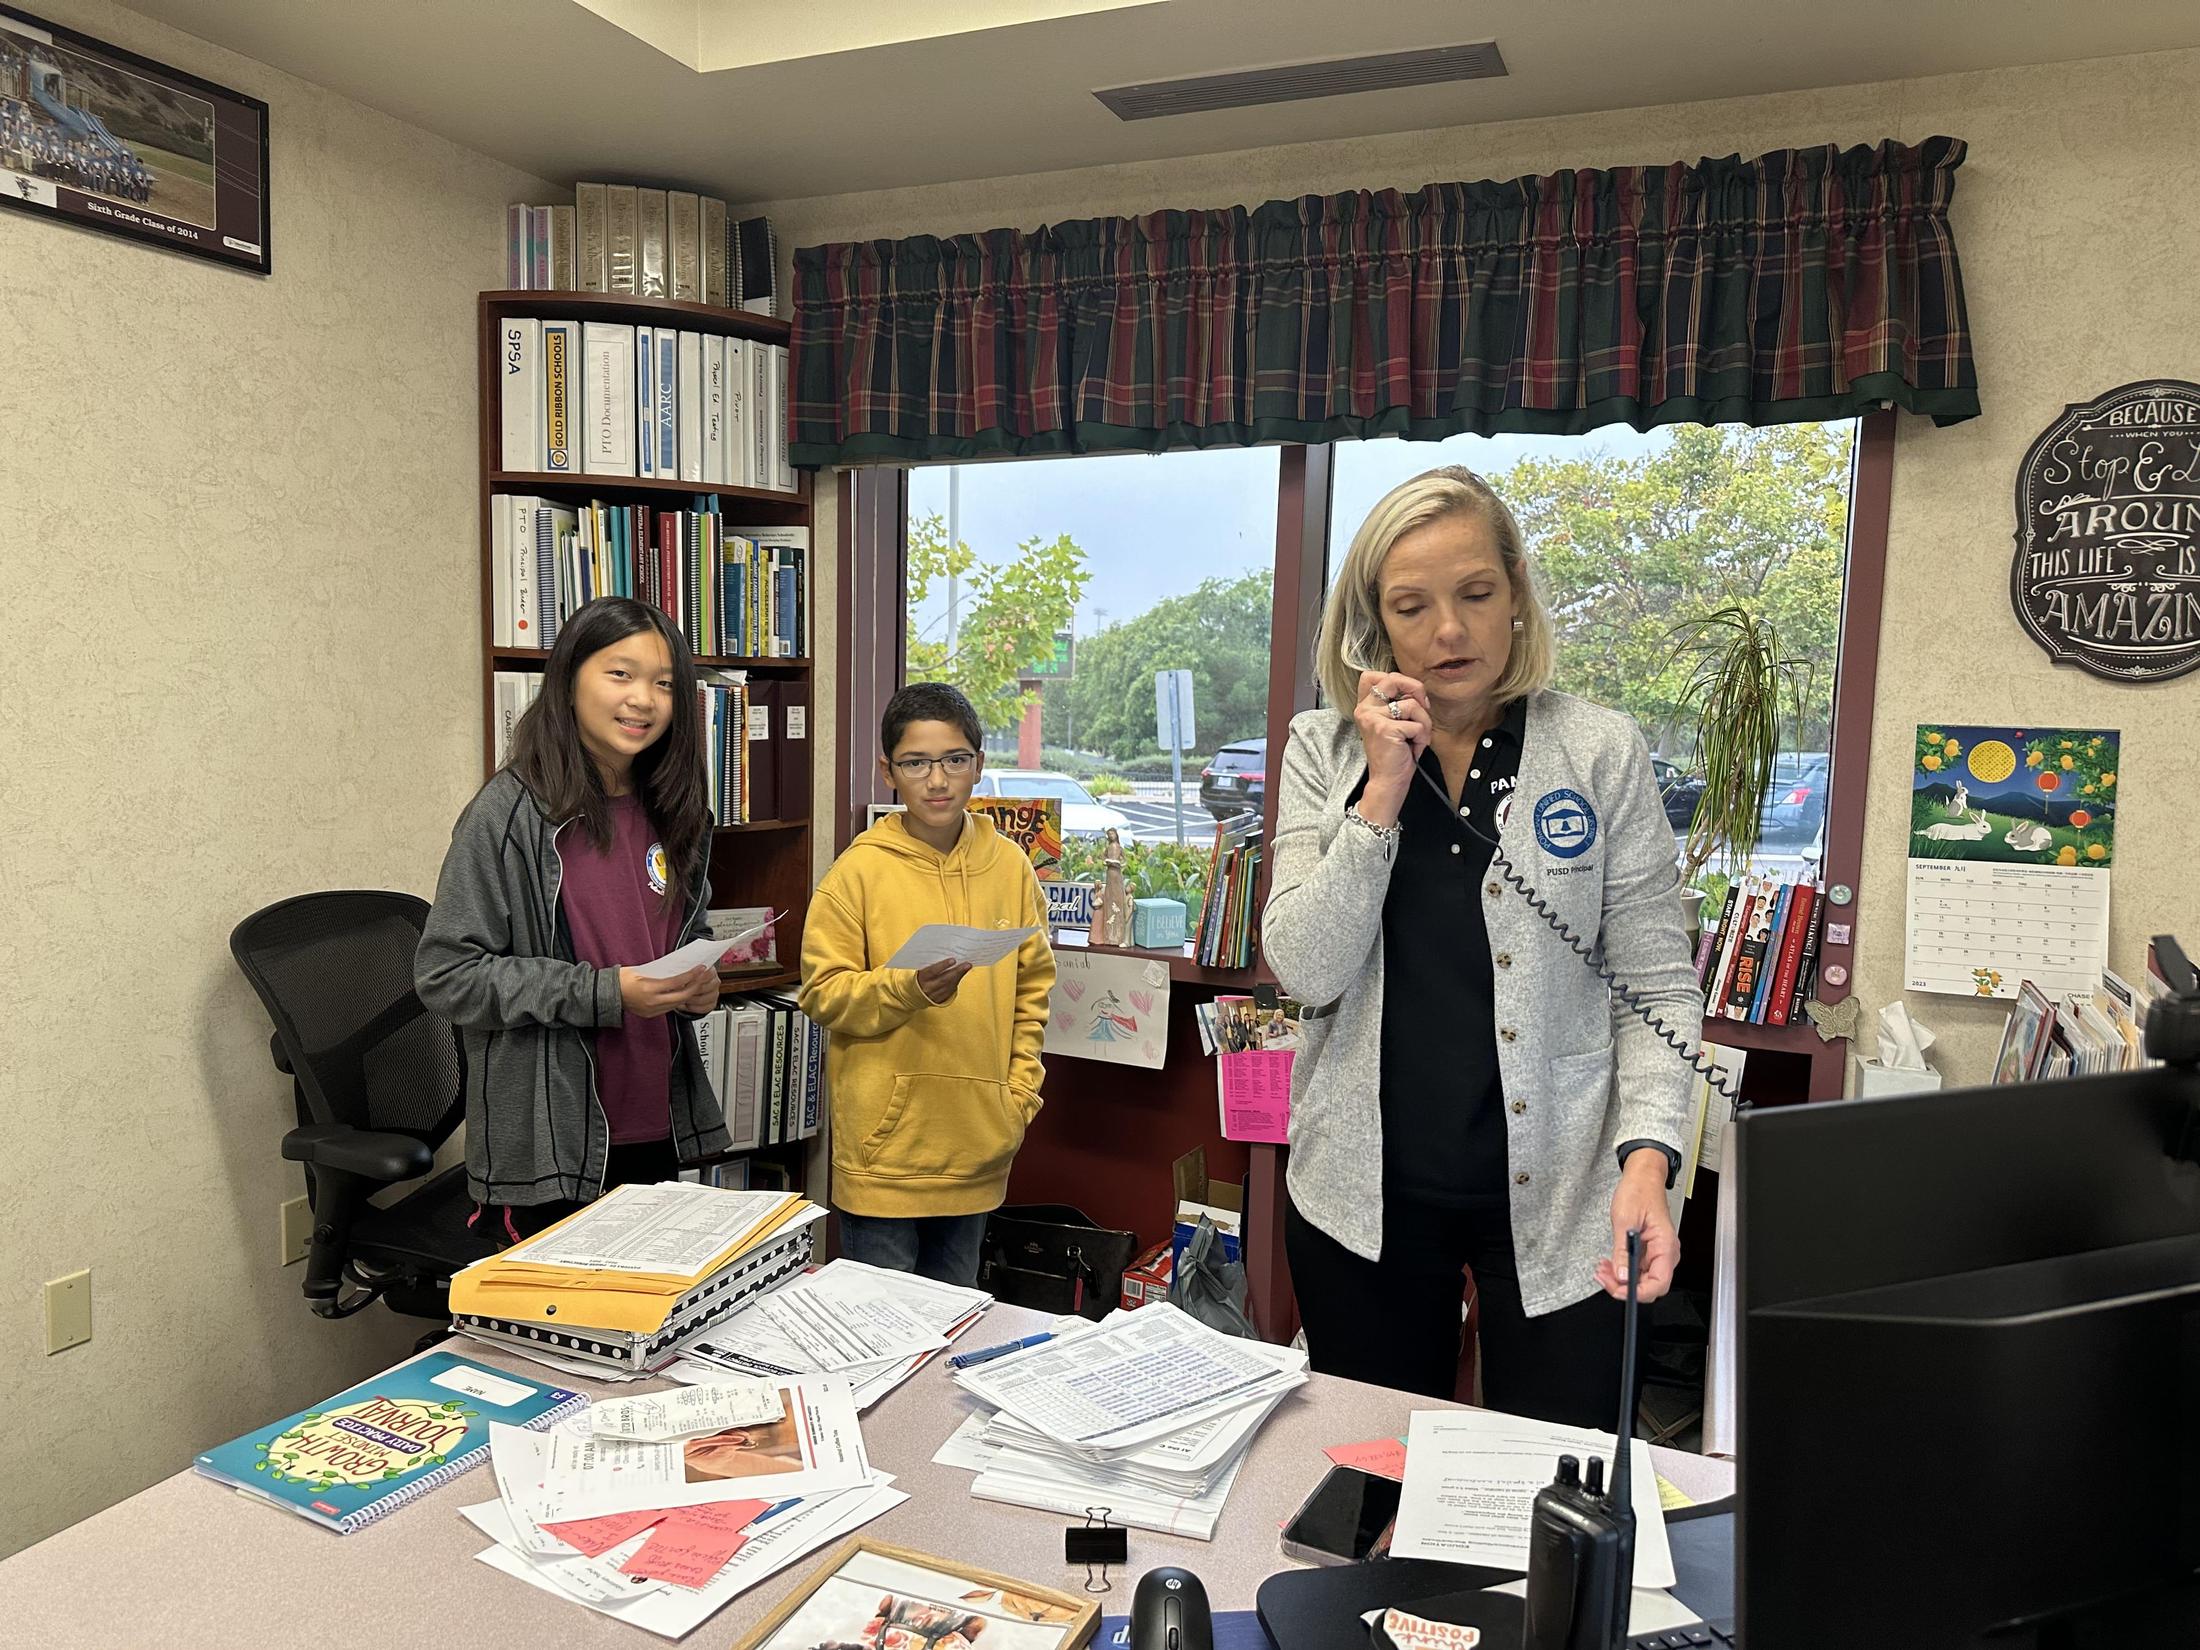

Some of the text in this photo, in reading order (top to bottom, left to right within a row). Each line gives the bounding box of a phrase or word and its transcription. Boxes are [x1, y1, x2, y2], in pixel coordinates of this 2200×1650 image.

[88, 202, 198, 240] Sixth Grade Class of 2014
[508, 329, 521, 375] SPSA
[555, 334, 563, 447] GOLD RIBBON SCHOOLS
[601, 351, 611, 454] PTO Documentation
[660, 383, 671, 427] AARC
[2110, 401, 2197, 426] BECAUSE
[2162, 430, 2185, 438] YOU
[2044, 440, 2130, 501] Stop
[2133, 442, 2172, 492] &
[2048, 501, 2200, 543] AROUN
[518, 547, 527, 581] Principal
[2030, 546, 2196, 579] THIS LIFE IS
[1547, 868, 1569, 876] PUSD
[1157, 915, 1183, 929] BELIEVE
[1725, 900, 1734, 918] START.
[1805, 920, 1818, 952] TALKING!
[1787, 945, 1795, 963] ATLAS
[1737, 955, 1754, 994] RISE
[1780, 978, 1788, 998] HEART
[700, 1022, 710, 1057] School
[776, 1024, 784, 1073] RESOURCES
[808, 1064, 817, 1090] ELAC
[790, 1078, 798, 1127] RESOURCES
[808, 1092, 816, 1103] &
[806, 1103, 814, 1126] SAC
[464, 1385, 487, 1396] NAME
[335, 1418, 421, 1453] DAILY PRACTICE
[355, 1397, 468, 1444] JOURNAL
[288, 1432, 390, 1477] GROWTH
[322, 1432, 390, 1458] MINDSET
[583, 1442, 595, 1470] 07:00 AM
[1387, 1612, 1474, 1643] POSITIVE
